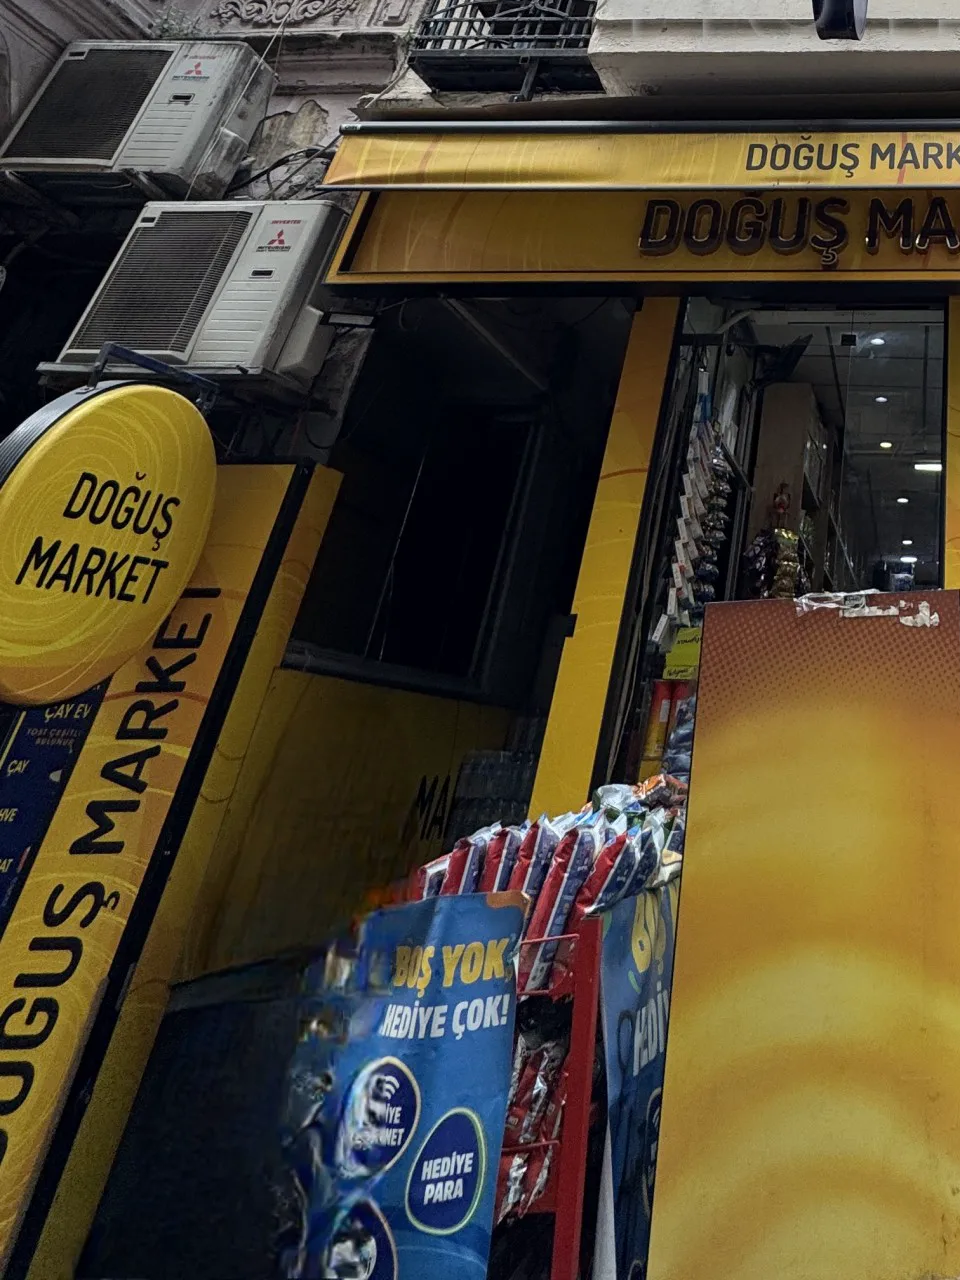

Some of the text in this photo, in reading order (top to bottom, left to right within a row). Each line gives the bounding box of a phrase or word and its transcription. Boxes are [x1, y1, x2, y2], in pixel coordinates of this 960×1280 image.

[746, 136, 860, 178] DOĞUŞ
[638, 192, 852, 269] DOĞUŞ
[63, 471, 181, 551] DOĞUŞ
[15, 535, 169, 604] MARKET
[7, 760, 30, 776] ÇAY
[392, 945, 435, 998] BOŞ
[378, 993, 511, 1041] HEDİYE ÇOK!
[421, 1151, 474, 1182] HEDİYE
[423, 1178, 464, 1206] PARA
